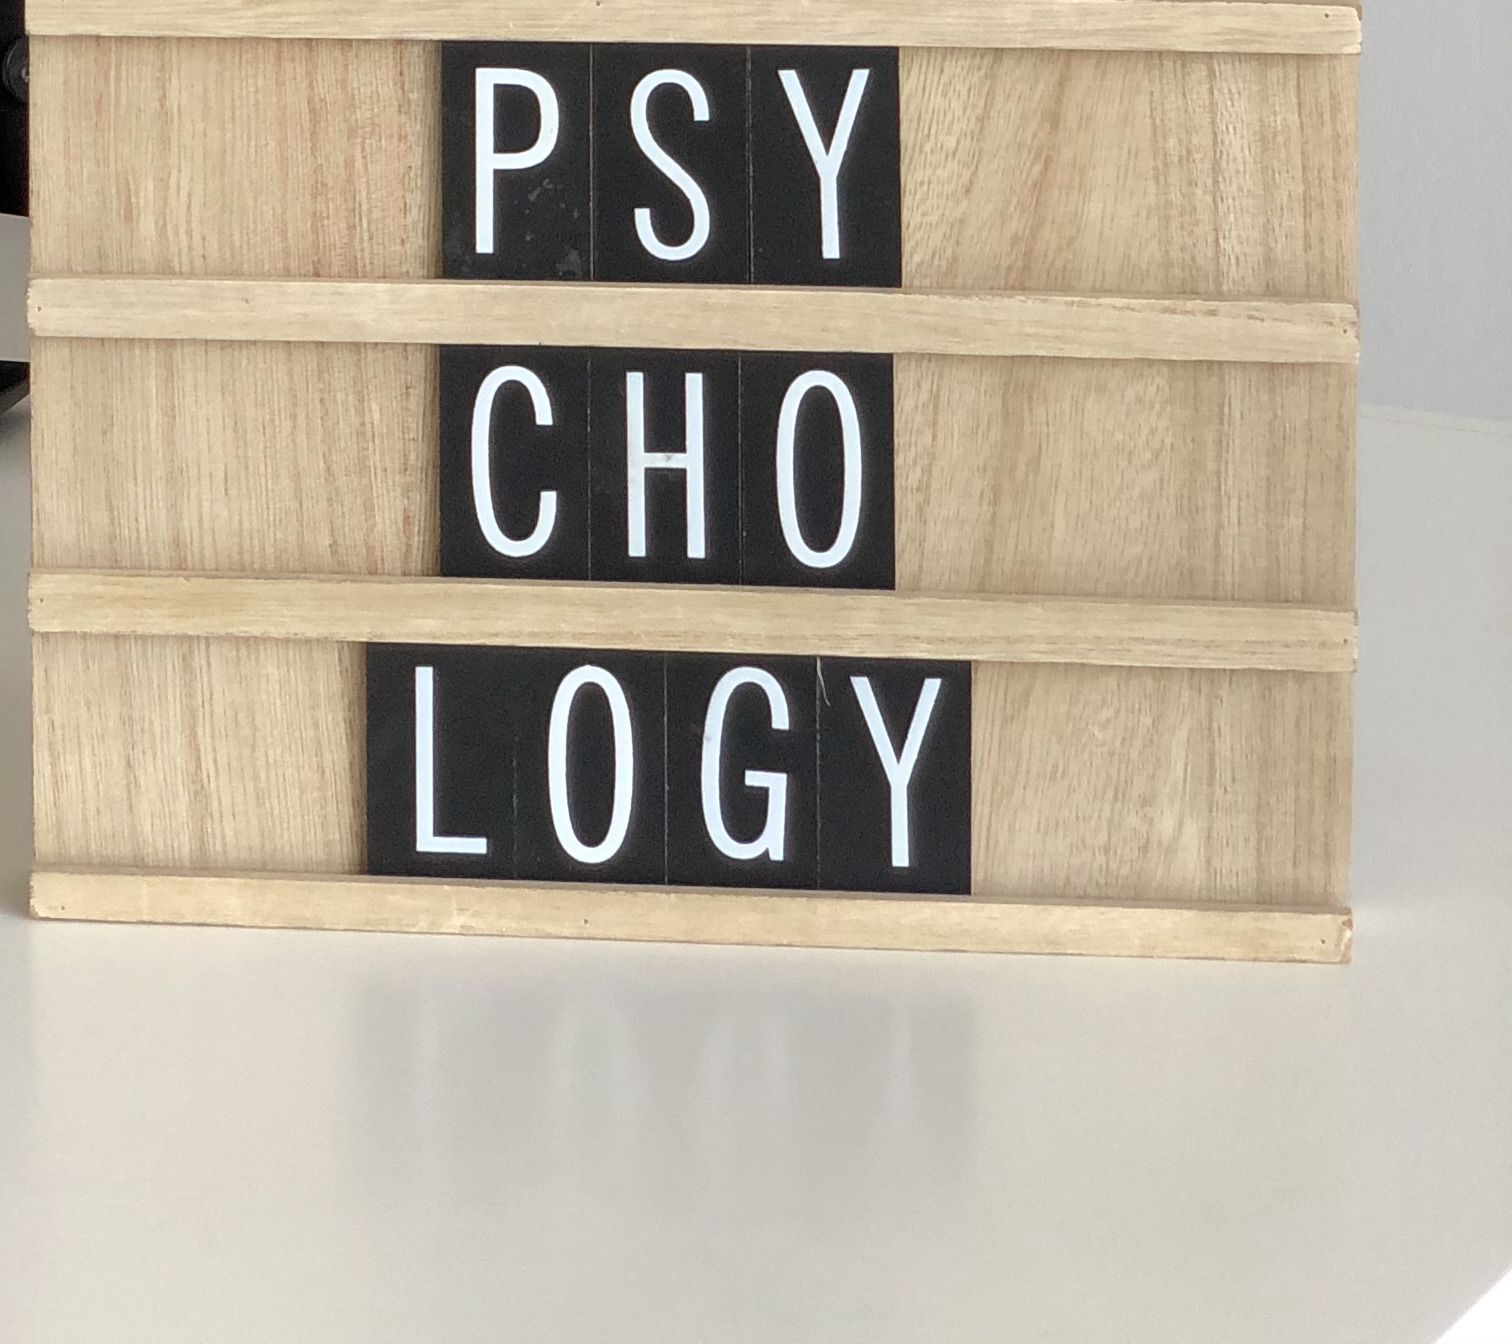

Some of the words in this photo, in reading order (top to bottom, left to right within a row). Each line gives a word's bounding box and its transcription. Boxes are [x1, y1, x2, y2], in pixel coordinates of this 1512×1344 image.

[473, 65, 872, 263] PSY
[469, 363, 864, 571] CHO
[413, 662, 944, 870] LOGY
